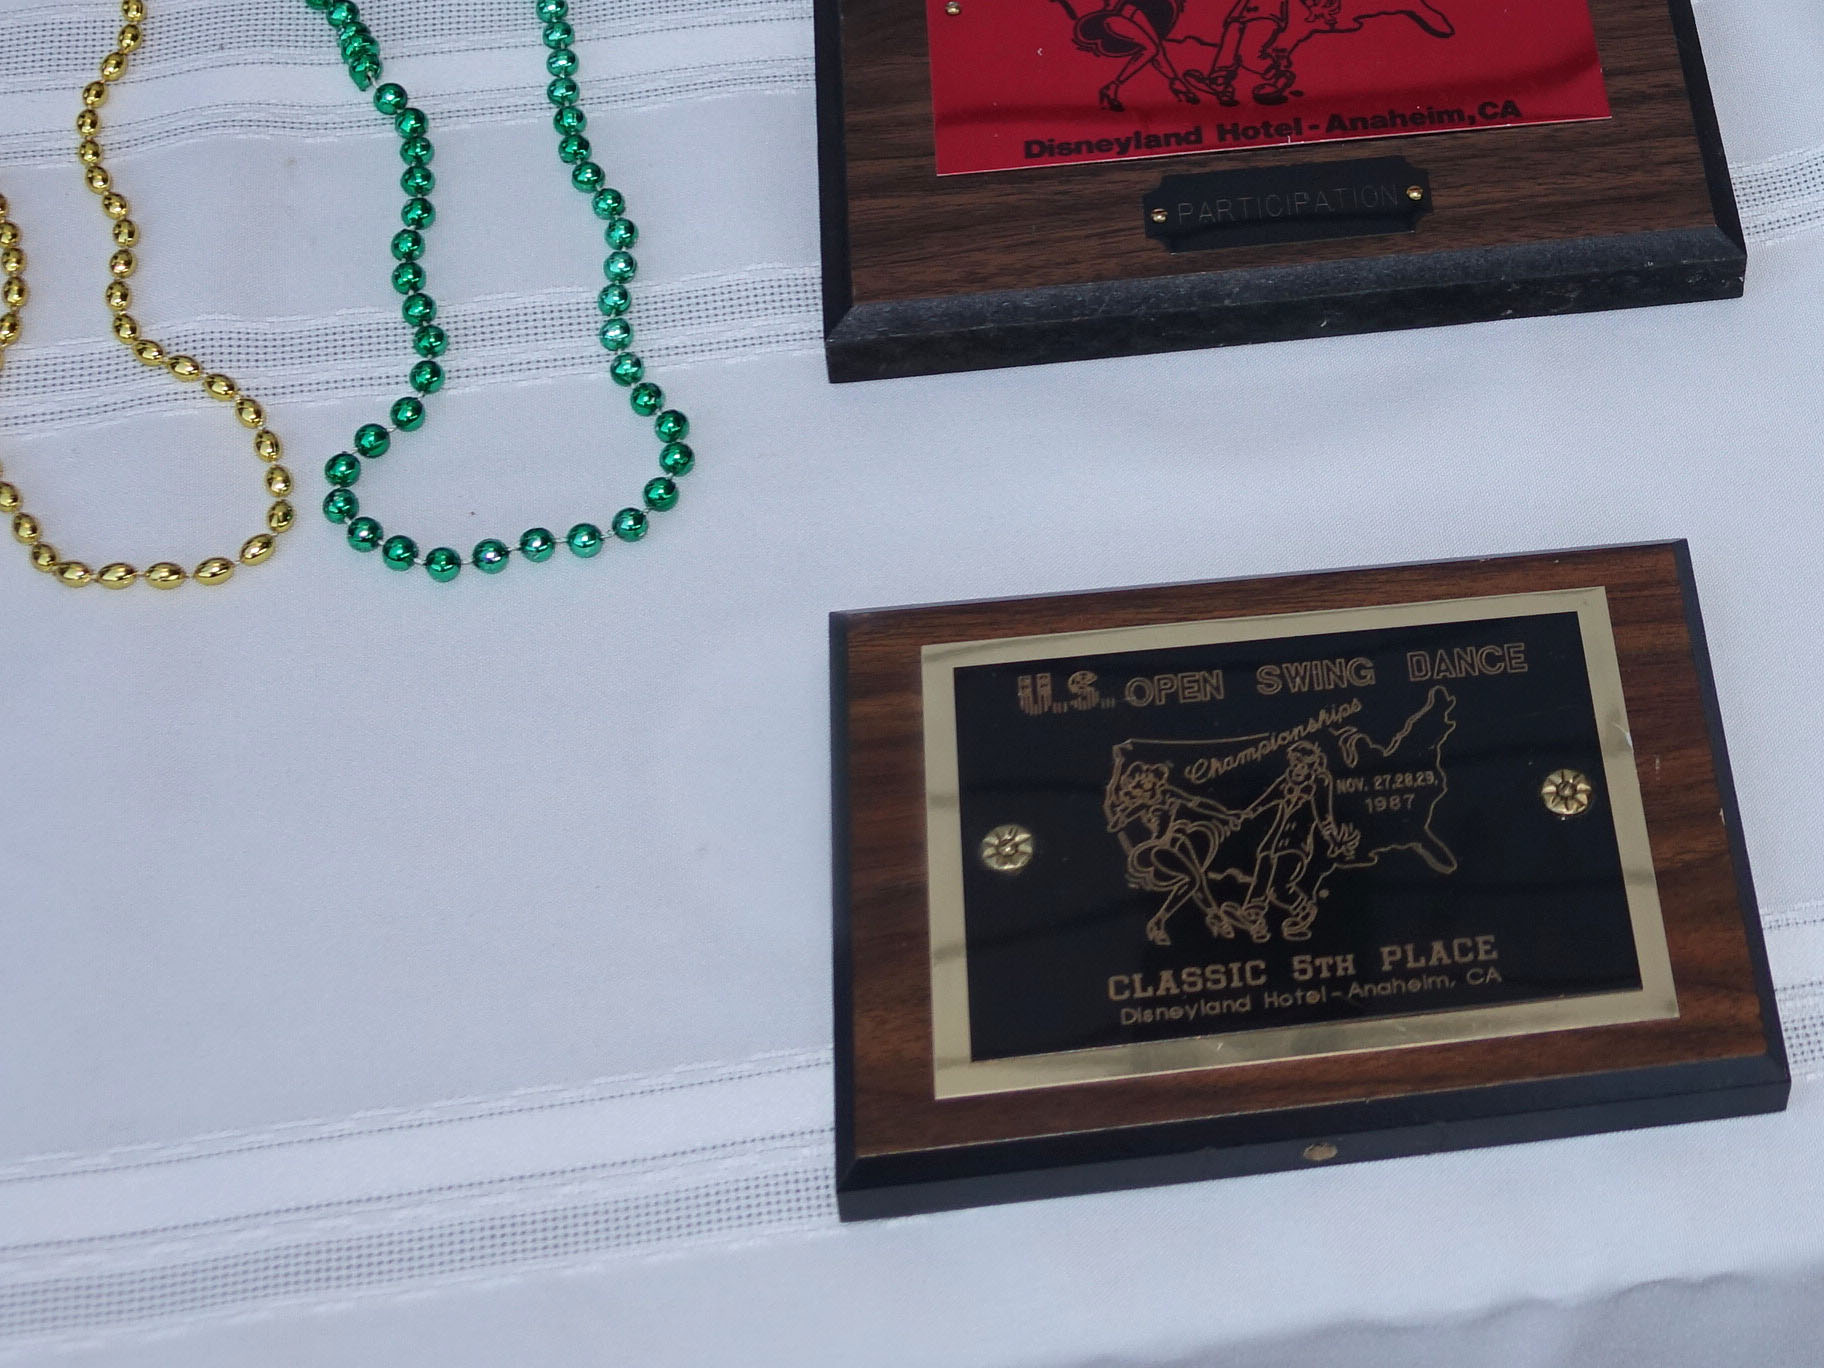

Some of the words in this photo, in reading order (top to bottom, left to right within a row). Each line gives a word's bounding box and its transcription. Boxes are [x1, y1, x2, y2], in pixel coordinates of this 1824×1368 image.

[1023, 127, 1205, 161] Disneyland
[1176, 183, 1400, 225] PARTICIPATION
[1124, 669, 1226, 708] OPEN
[1256, 656, 1377, 696] SWING
[1406, 642, 1529, 682] DANCE
[1183, 696, 1363, 784] Championships
[1336, 776, 1369, 794] NOV.
[1364, 793, 1416, 814] 1987
[1107, 959, 1268, 1002] CLASSIC
[1291, 953, 1357, 981] 5TH
[1379, 934, 1499, 972] PLACE
[1120, 994, 1252, 1026] Disneyland
[1465, 965, 1502, 987] CA
